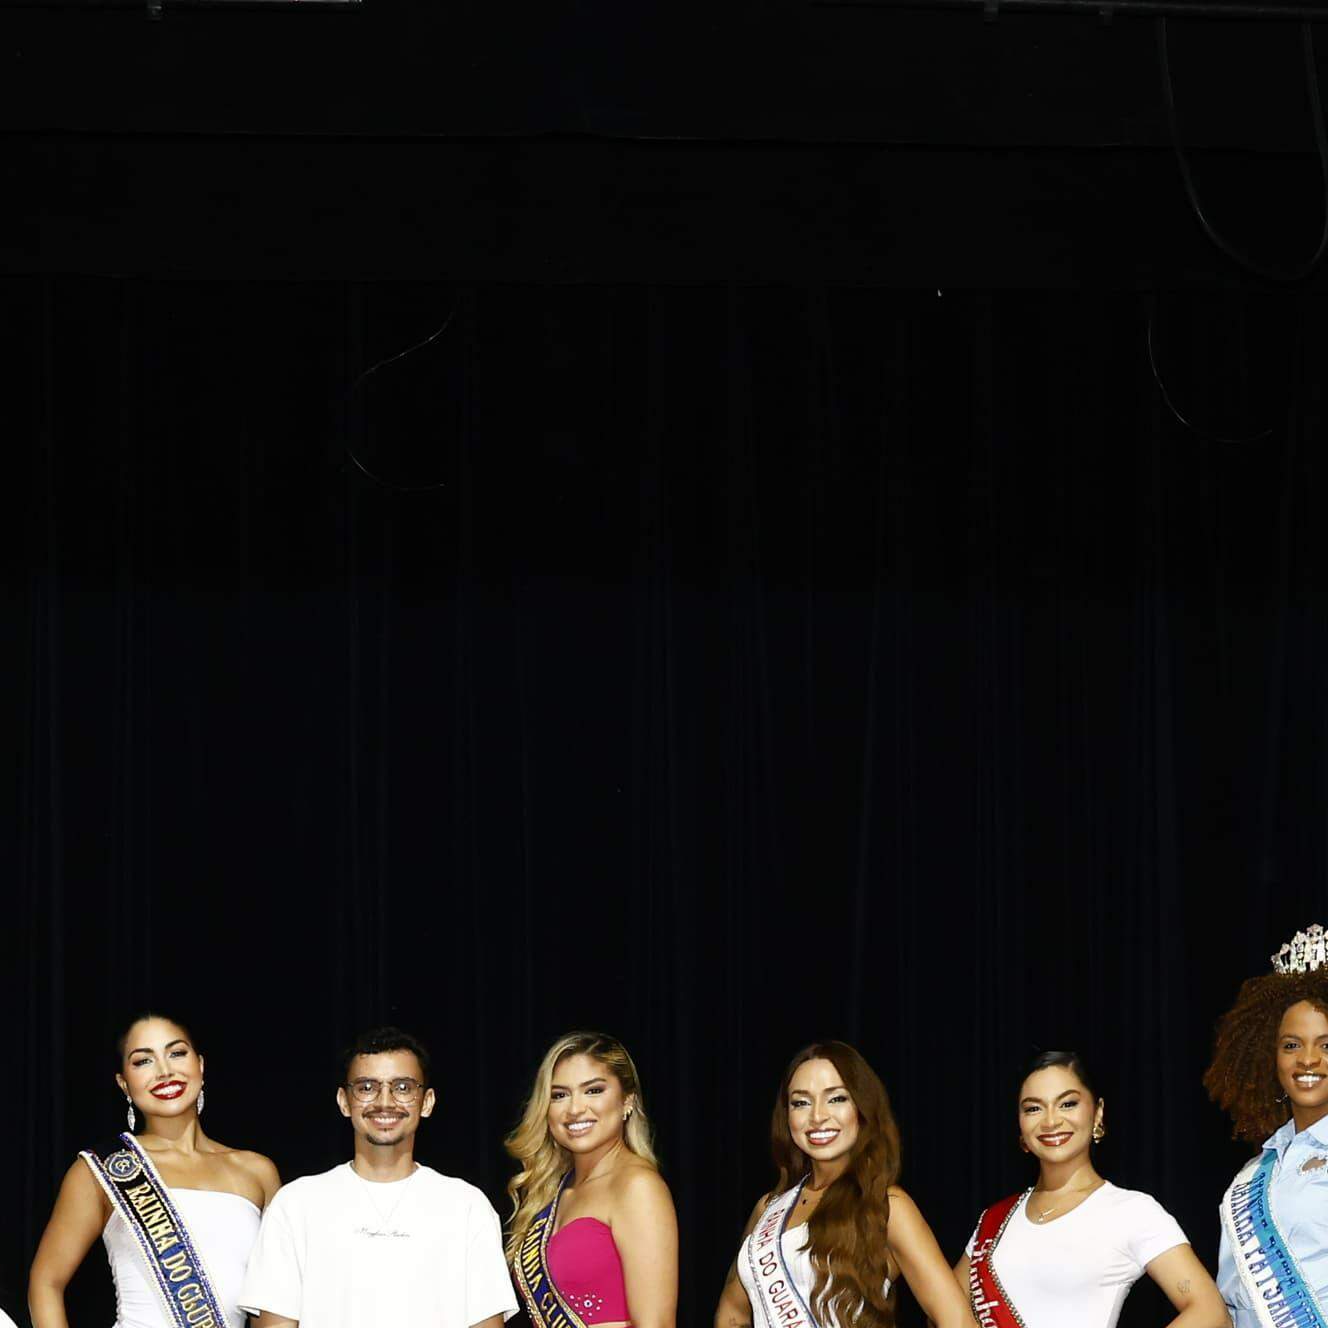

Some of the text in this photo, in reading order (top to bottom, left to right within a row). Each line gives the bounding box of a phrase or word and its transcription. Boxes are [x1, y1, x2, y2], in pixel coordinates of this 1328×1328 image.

[126, 1182, 180, 1253] RAINHA
[161, 1252, 194, 1283] DO
[1231, 1171, 1269, 1247] RAINHA
[759, 1252, 777, 1277] DO
